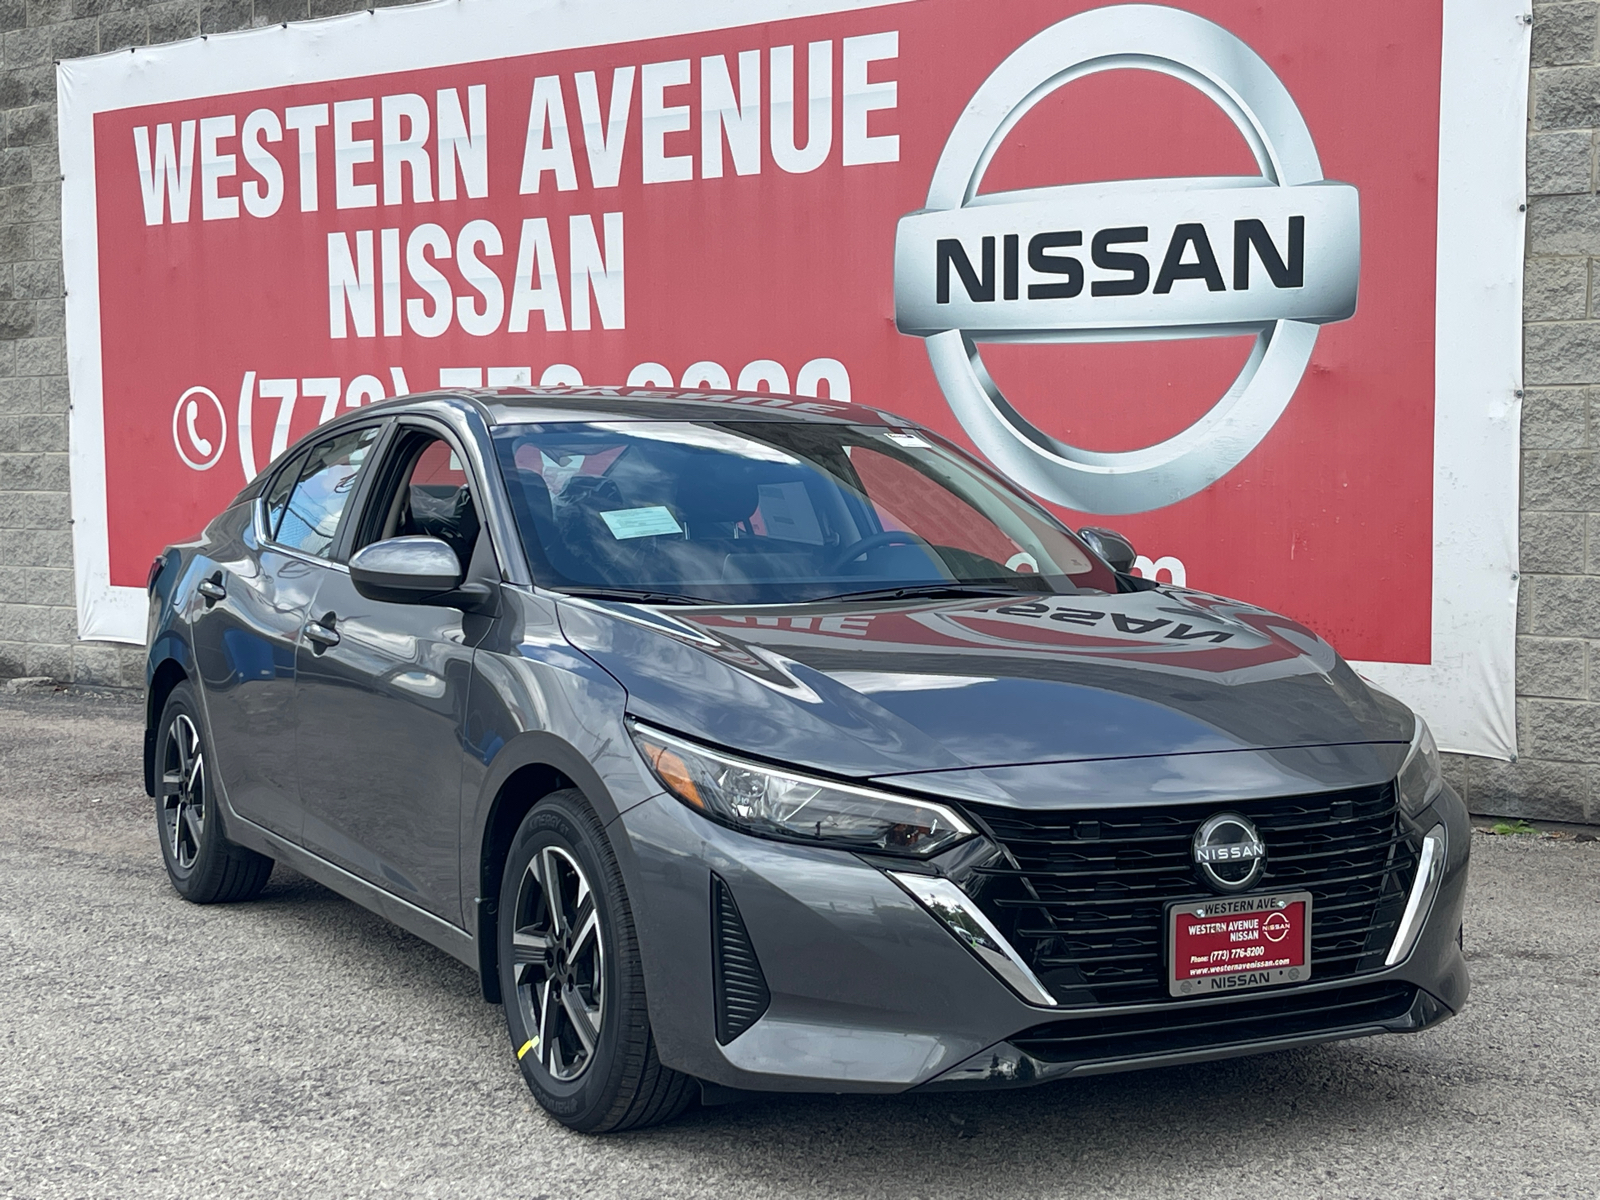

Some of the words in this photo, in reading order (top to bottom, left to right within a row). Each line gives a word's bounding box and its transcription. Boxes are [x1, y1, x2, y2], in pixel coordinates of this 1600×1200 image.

[133, 83, 488, 226] WESTERN
[519, 31, 900, 195] AVENUE
[936, 215, 1305, 304] NISSAN
[327, 211, 626, 338] NISSAN
[1197, 843, 1263, 861] NISSAN
[1205, 900, 1254, 915] WESTERN
[1188, 923, 1227, 935] WESTERN
[1228, 918, 1259, 931] AVENUE
[1262, 923, 1291, 931] NISSAN
[1229, 930, 1259, 943] NISSAN
[1210, 949, 1230, 964] (773)
[1189, 958, 1290, 976] www.westernavenissan.com
[1211, 971, 1270, 990] NISSAN
